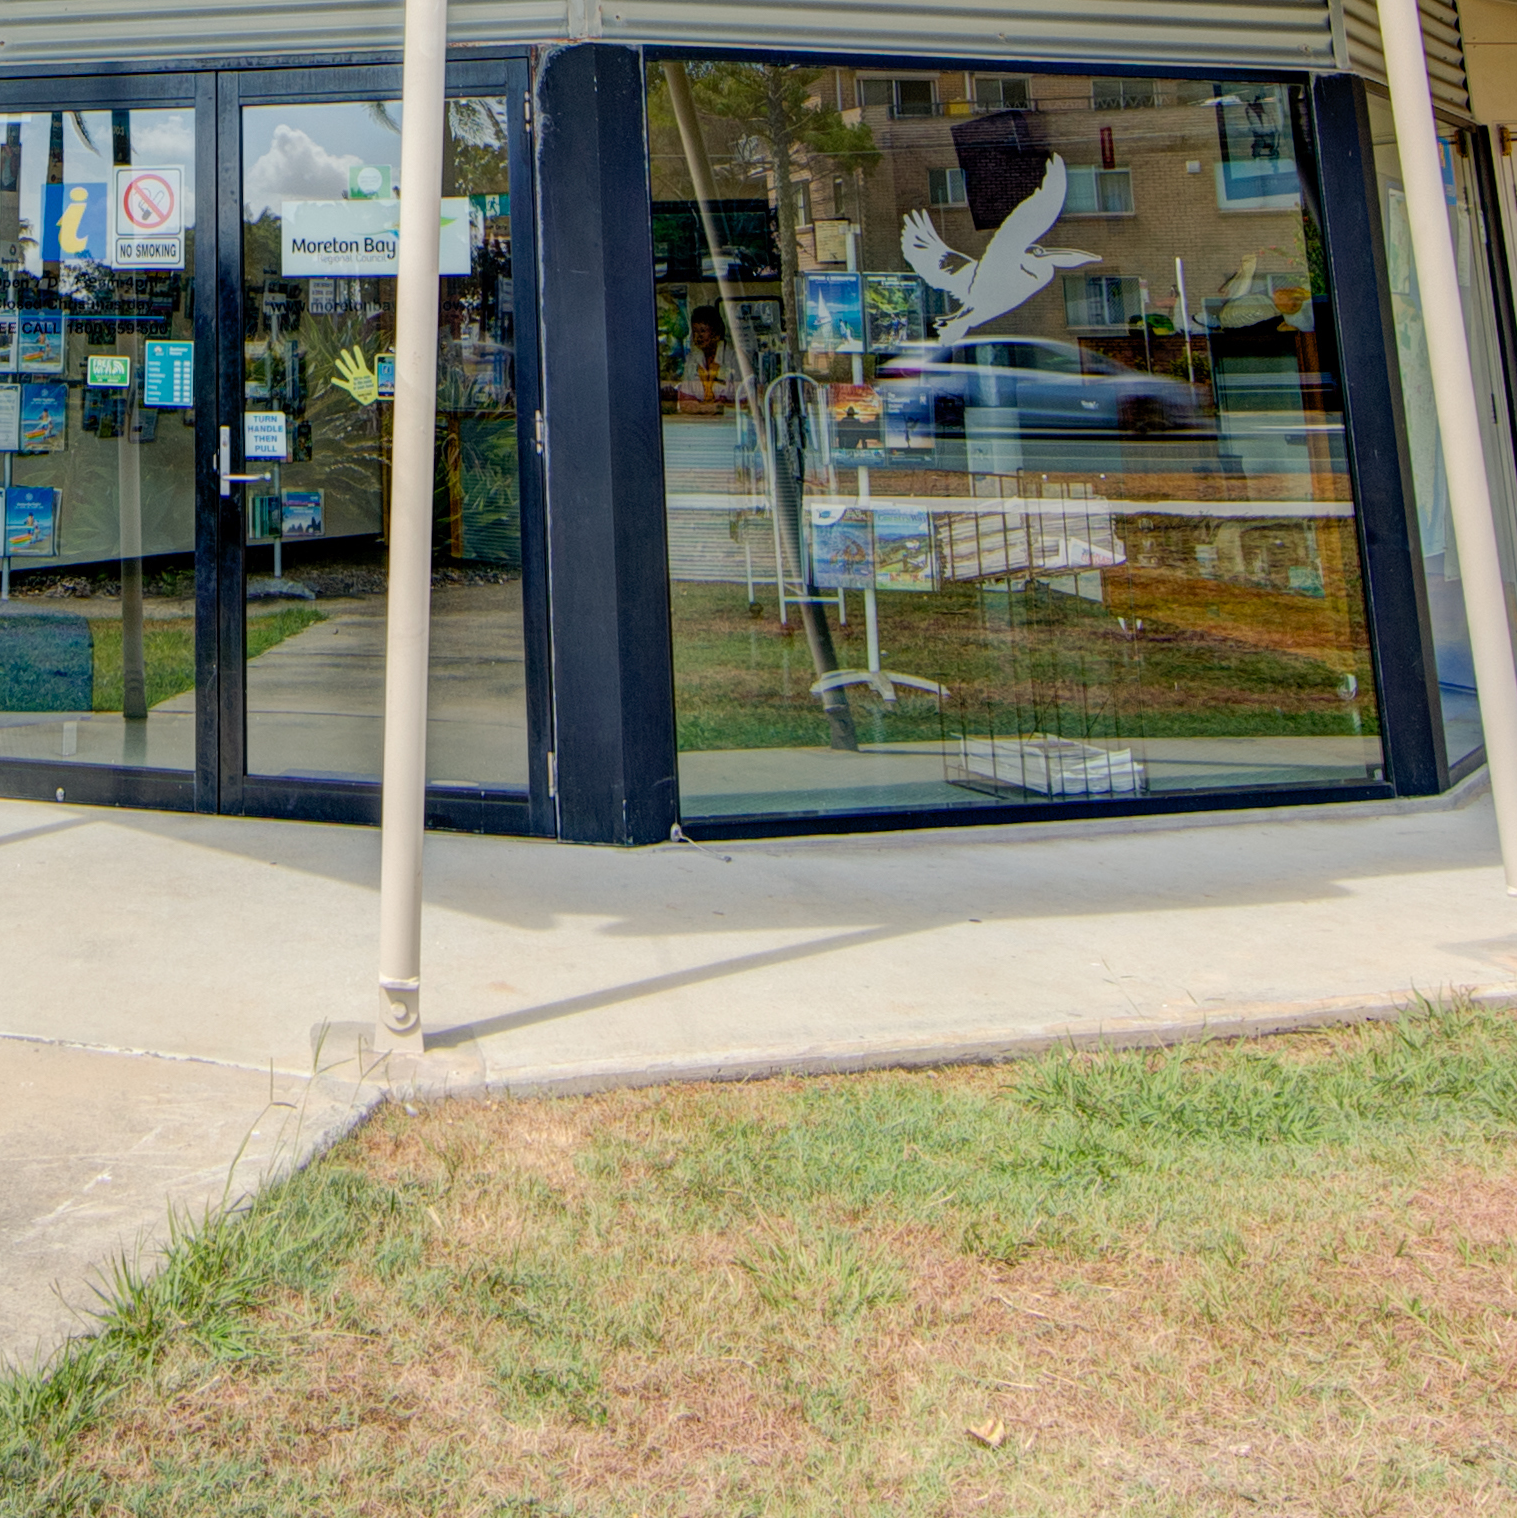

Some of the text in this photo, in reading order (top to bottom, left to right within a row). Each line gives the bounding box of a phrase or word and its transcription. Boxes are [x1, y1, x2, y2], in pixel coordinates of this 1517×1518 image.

[119, 243, 177, 258] NO SMOKING
[291, 236, 397, 260] Moreton Bay
[317, 253, 387, 265] Regional Council
[47, 297, 122, 310] Chrismas
[21, 321, 62, 335] CALL
[66, 322, 103, 335] 1800
[253, 415, 278, 423] TURN
[247, 425, 283, 433] HANDLE
[253, 435, 278, 443] THEN
[254, 445, 278, 453] PULL
